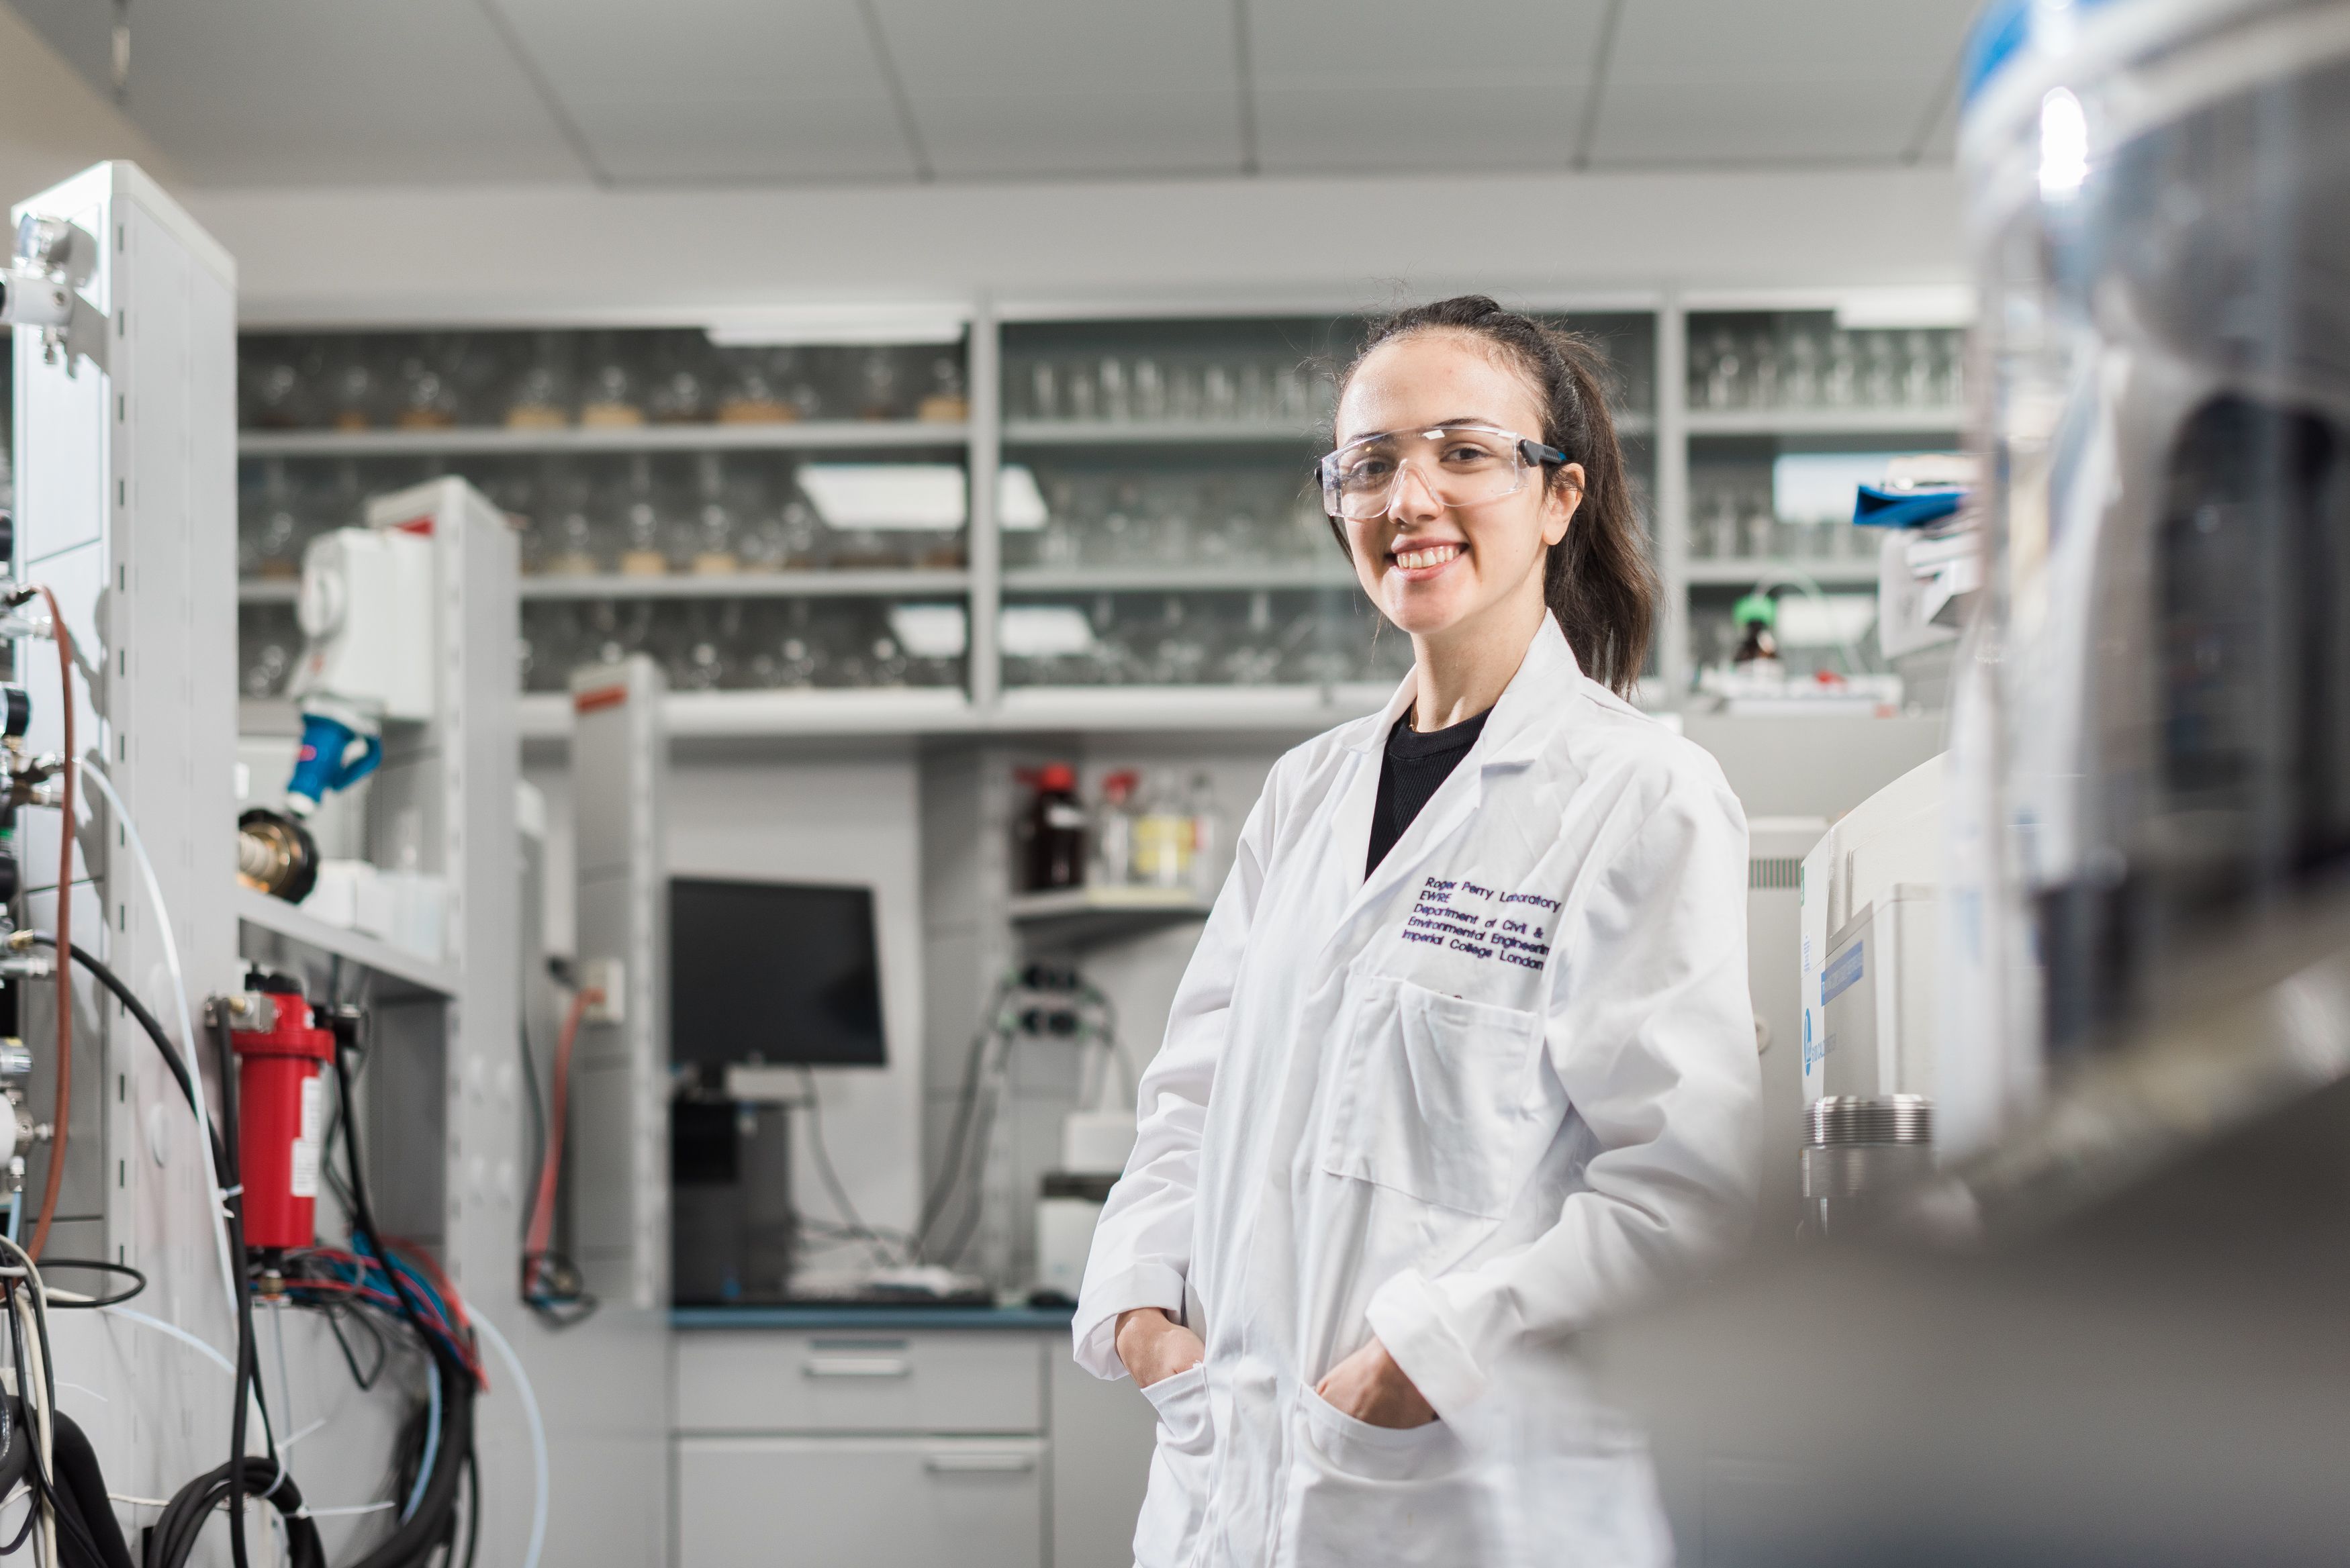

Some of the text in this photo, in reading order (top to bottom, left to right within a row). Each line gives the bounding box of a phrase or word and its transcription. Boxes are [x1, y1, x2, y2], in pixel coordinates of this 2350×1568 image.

[1419, 890, 1452, 903] EWRE
[1425, 877, 1562, 913] Roger Perry Laboratory
[1408, 916, 1550, 956] Environmental Engineerin
[1413, 903, 1544, 938] Department of Civil &
[1402, 929, 1544, 971] Imperial College London
